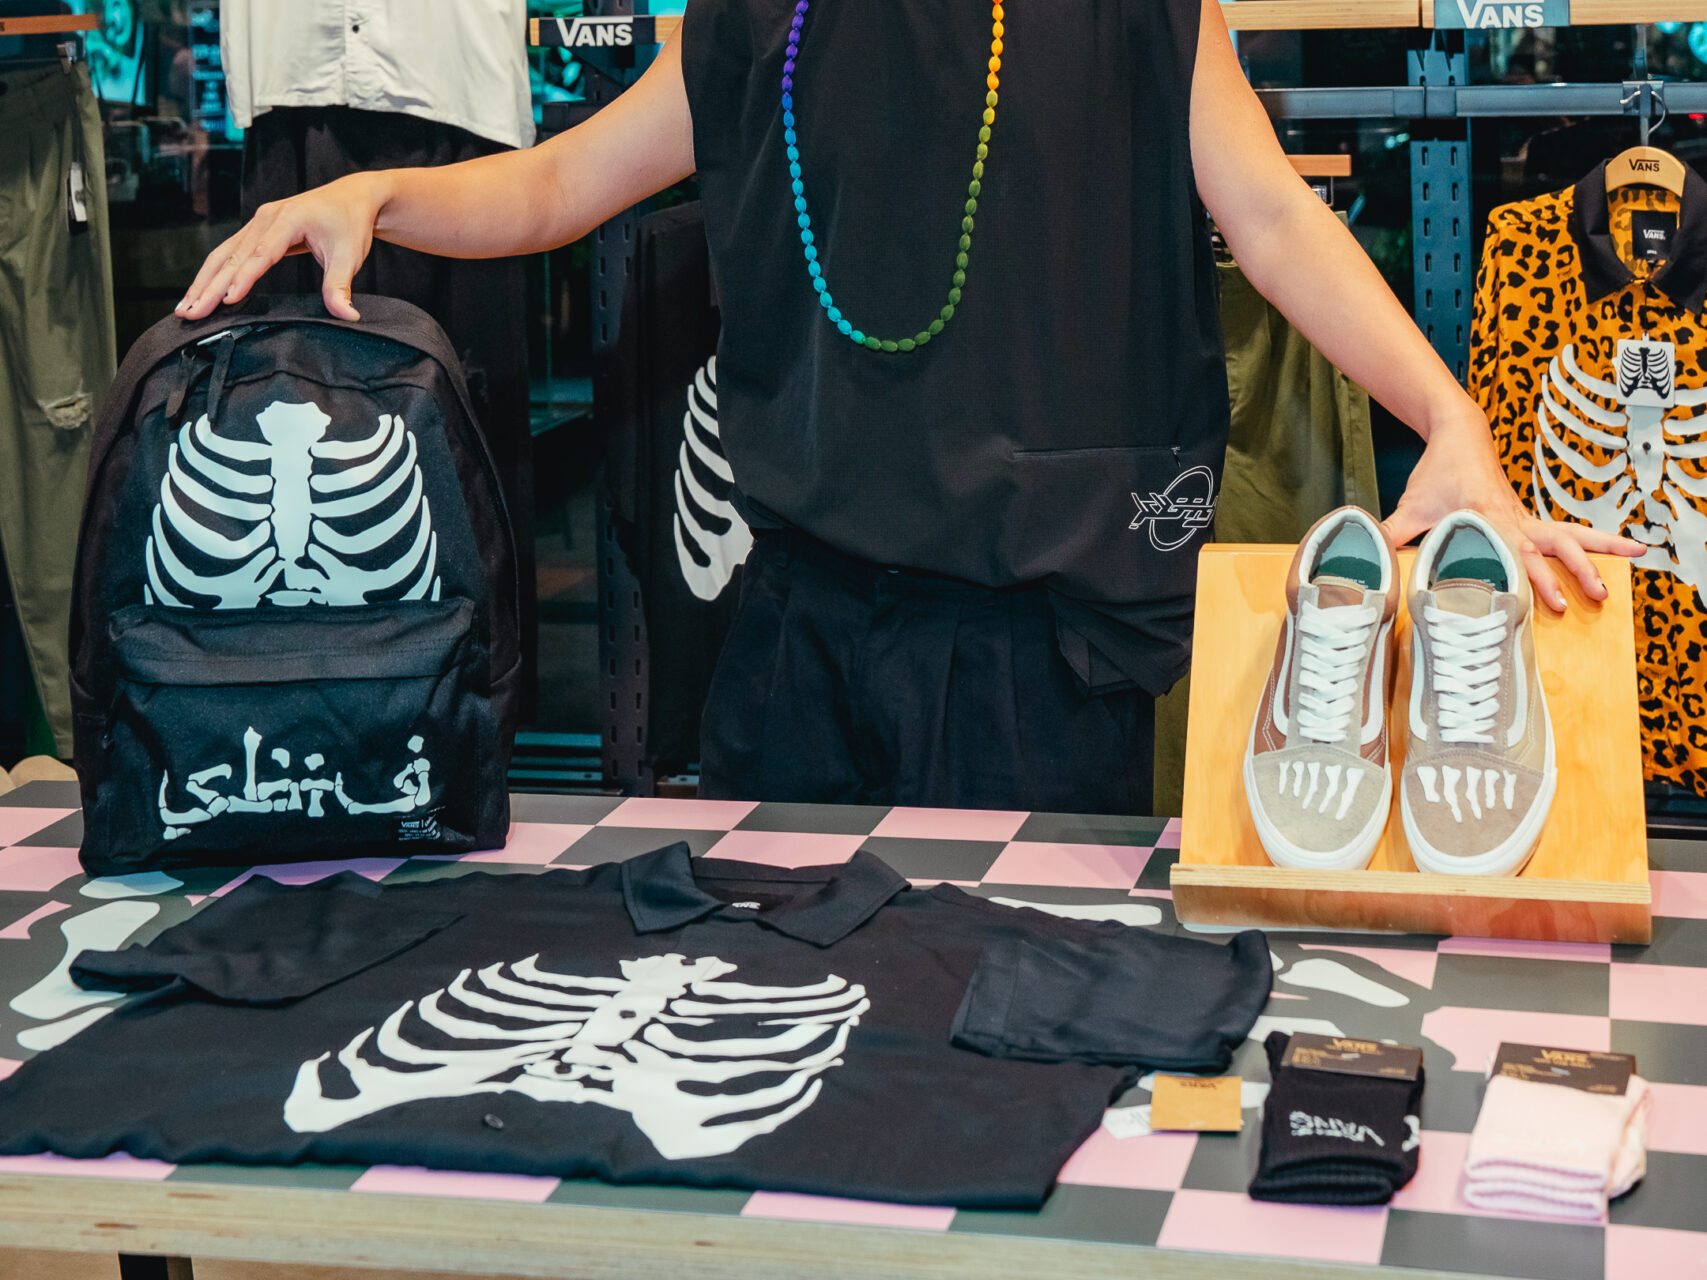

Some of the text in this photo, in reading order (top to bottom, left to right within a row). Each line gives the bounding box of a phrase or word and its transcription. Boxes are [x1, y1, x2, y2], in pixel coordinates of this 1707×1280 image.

[556, 16, 633, 47] VANS
[1628, 158, 1660, 172] VANS
[1643, 228, 1665, 240] VANS
[1332, 1038, 1378, 1052] VANS
[1540, 1048, 1589, 1063] VANS
